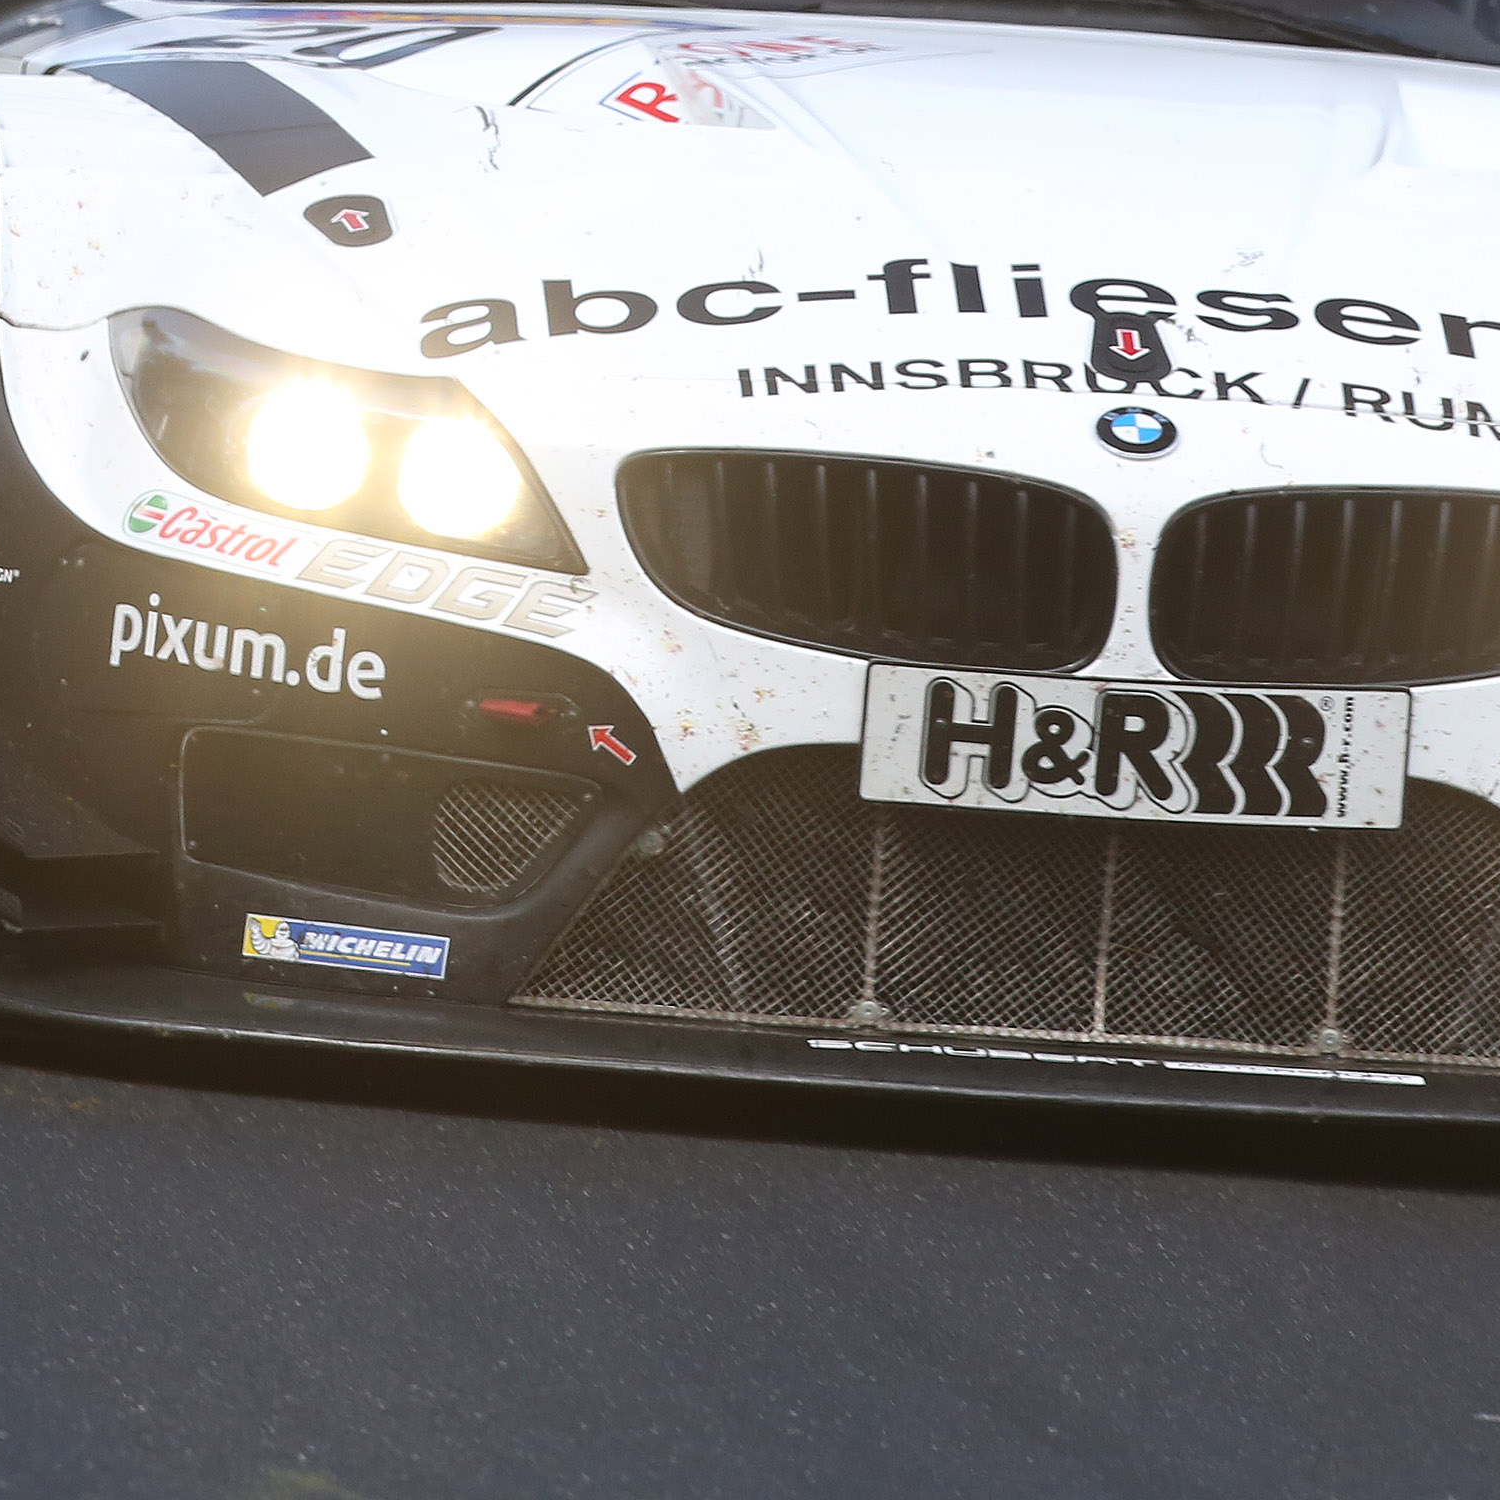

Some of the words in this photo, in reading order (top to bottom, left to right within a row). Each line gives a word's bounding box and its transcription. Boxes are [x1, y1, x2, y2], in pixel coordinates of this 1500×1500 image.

[737, 357, 1274, 405] INNSBRUCK
[157, 505, 299, 568] Castrol
[295, 539, 601, 638] EDGE
[108, 592, 387, 700] pixum.de
[299, 930, 444, 965] MICHELIN
